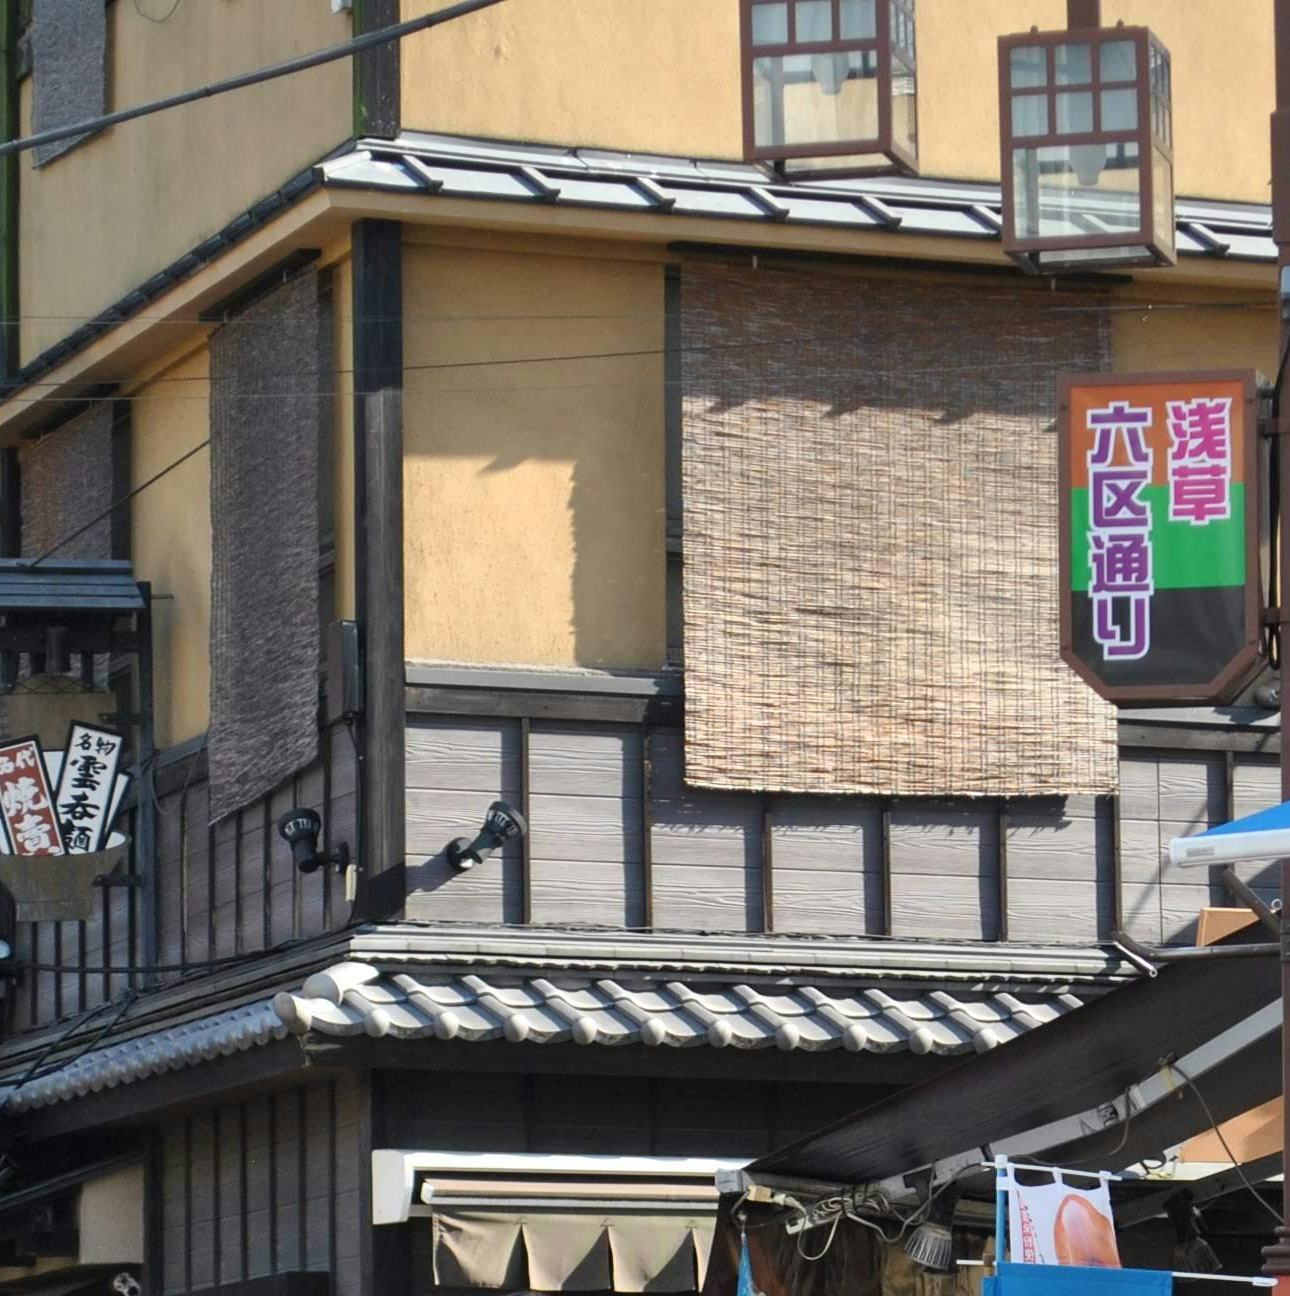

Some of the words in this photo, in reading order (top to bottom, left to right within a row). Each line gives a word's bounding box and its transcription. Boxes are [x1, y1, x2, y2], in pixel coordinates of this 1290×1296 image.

[1166, 397, 1232, 525] 浅草
[1086, 400, 1153, 661] 六区通り
[75, 733, 117, 756] 名物
